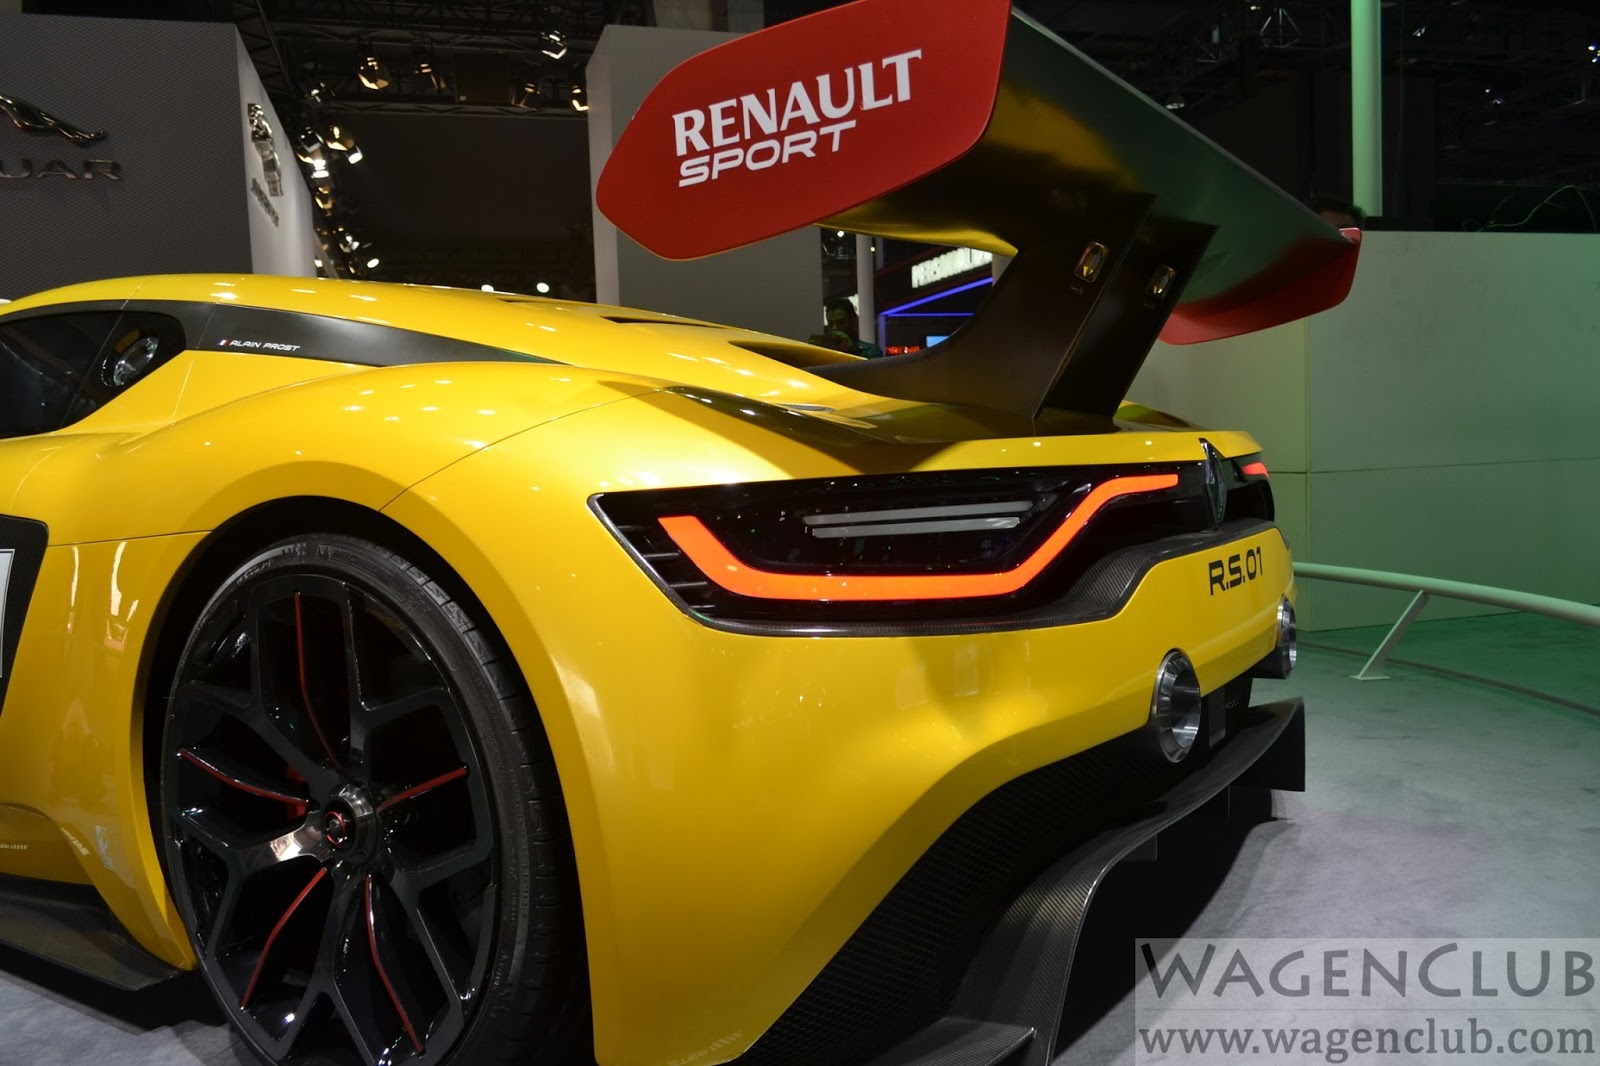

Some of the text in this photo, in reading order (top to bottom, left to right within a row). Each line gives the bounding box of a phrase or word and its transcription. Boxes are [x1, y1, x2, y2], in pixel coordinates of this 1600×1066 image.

[672, 48, 922, 157] RENAULT
[678, 119, 857, 188] SPORT
[229, 339, 301, 352] ALAIN PROST
[1208, 545, 1263, 596] R.S.01
